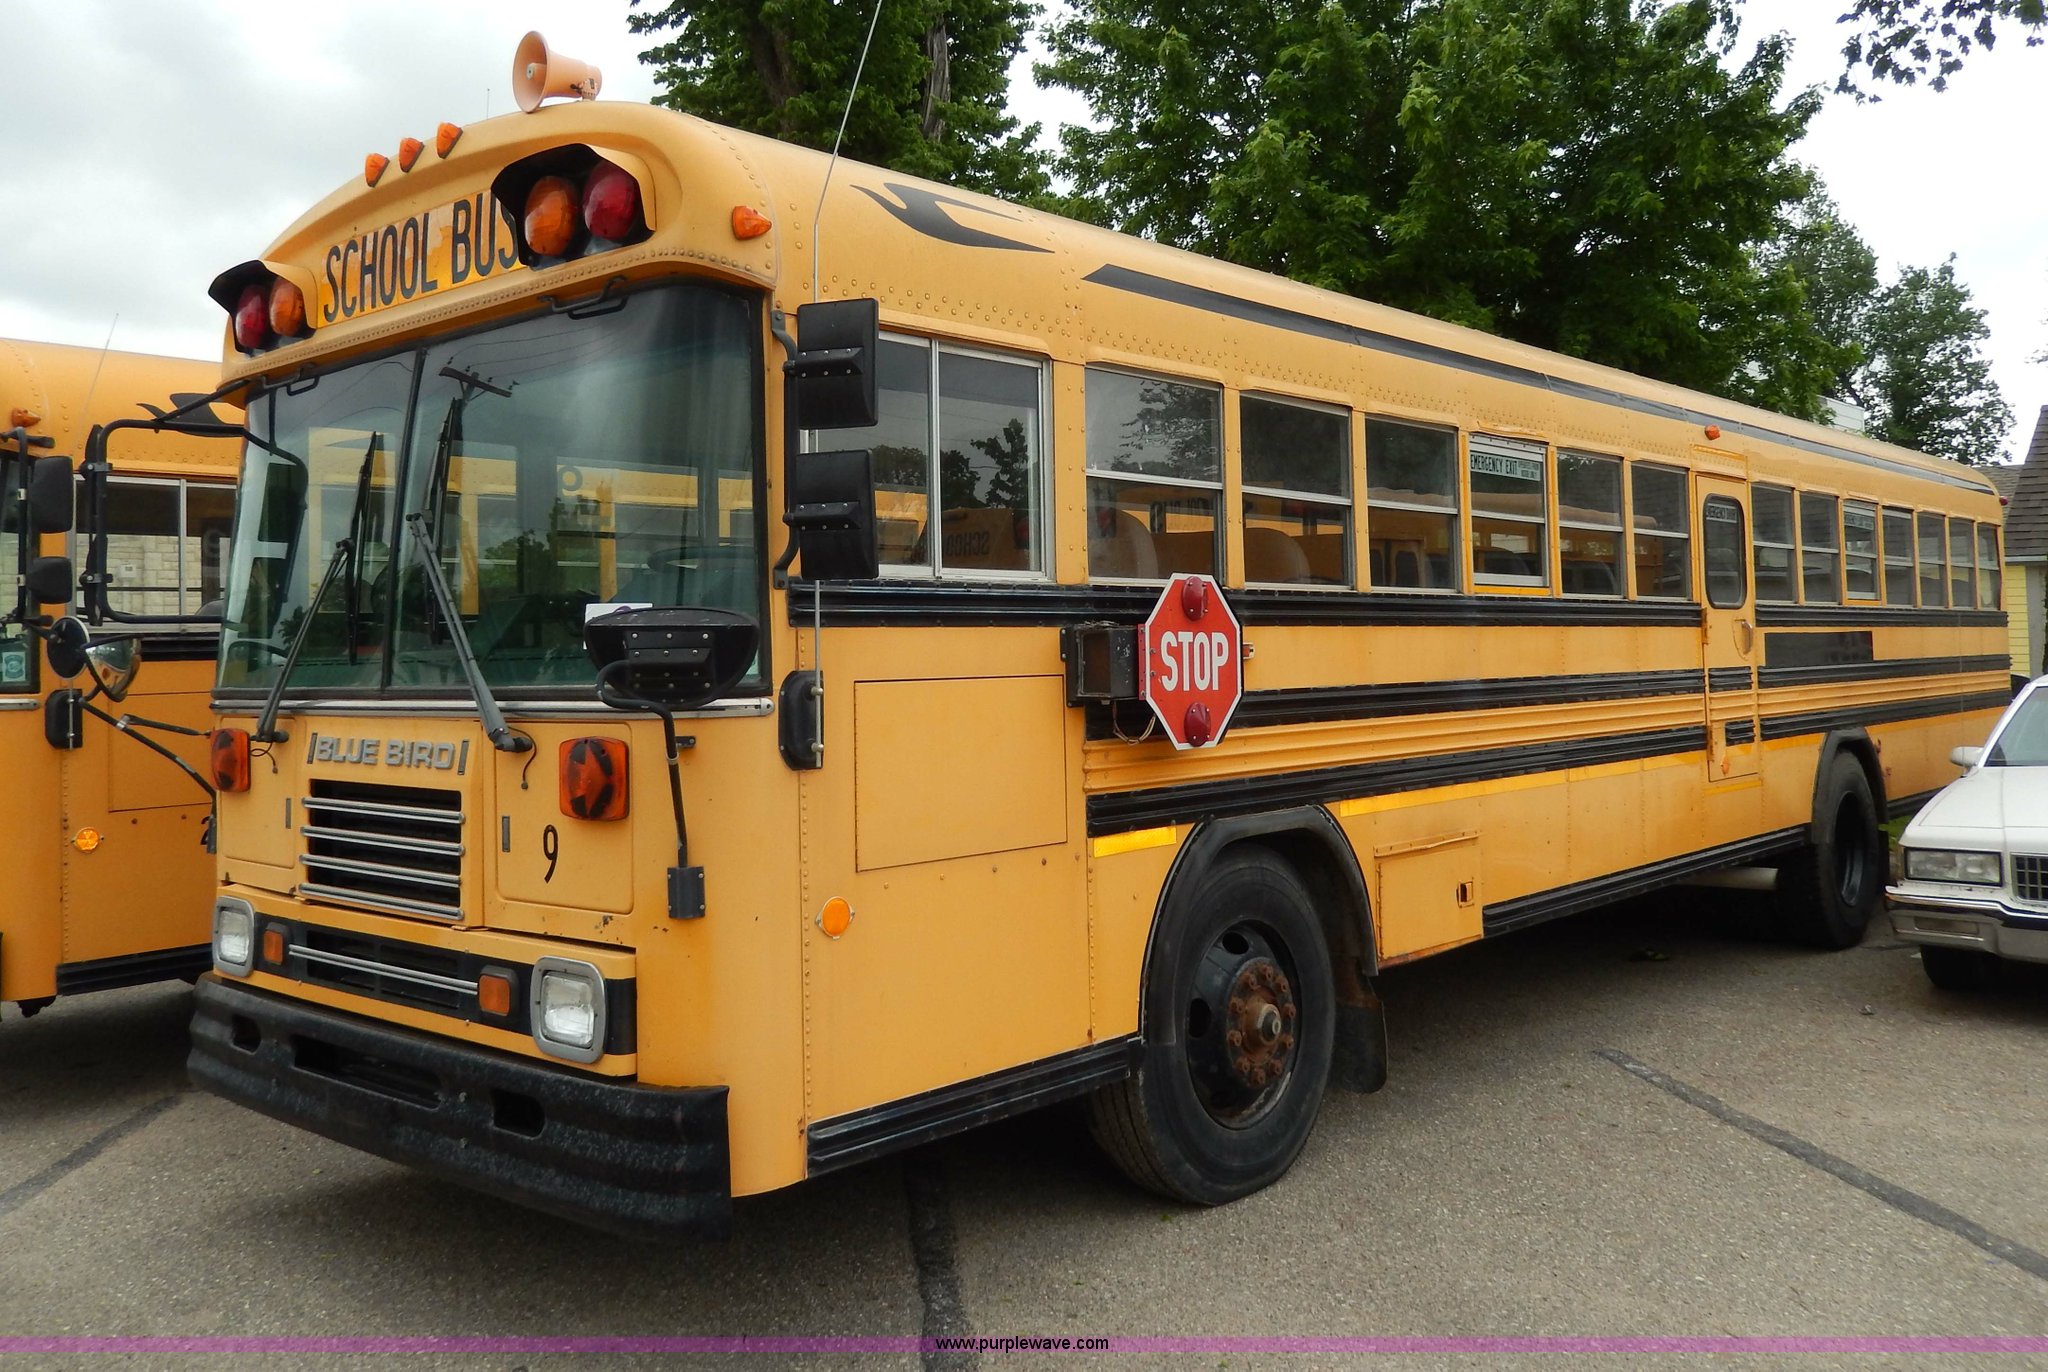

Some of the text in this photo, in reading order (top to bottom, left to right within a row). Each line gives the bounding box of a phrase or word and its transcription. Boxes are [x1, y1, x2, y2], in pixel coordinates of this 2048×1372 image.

[323, 190, 520, 323] SCHOOL BUS
[1470, 453, 1504, 474] EMERGENCY
[1505, 459, 1518, 476] EXIT
[1160, 631, 1229, 692] STOP
[315, 735, 456, 770] BLUE BIRD
[542, 824, 559, 884] 9
